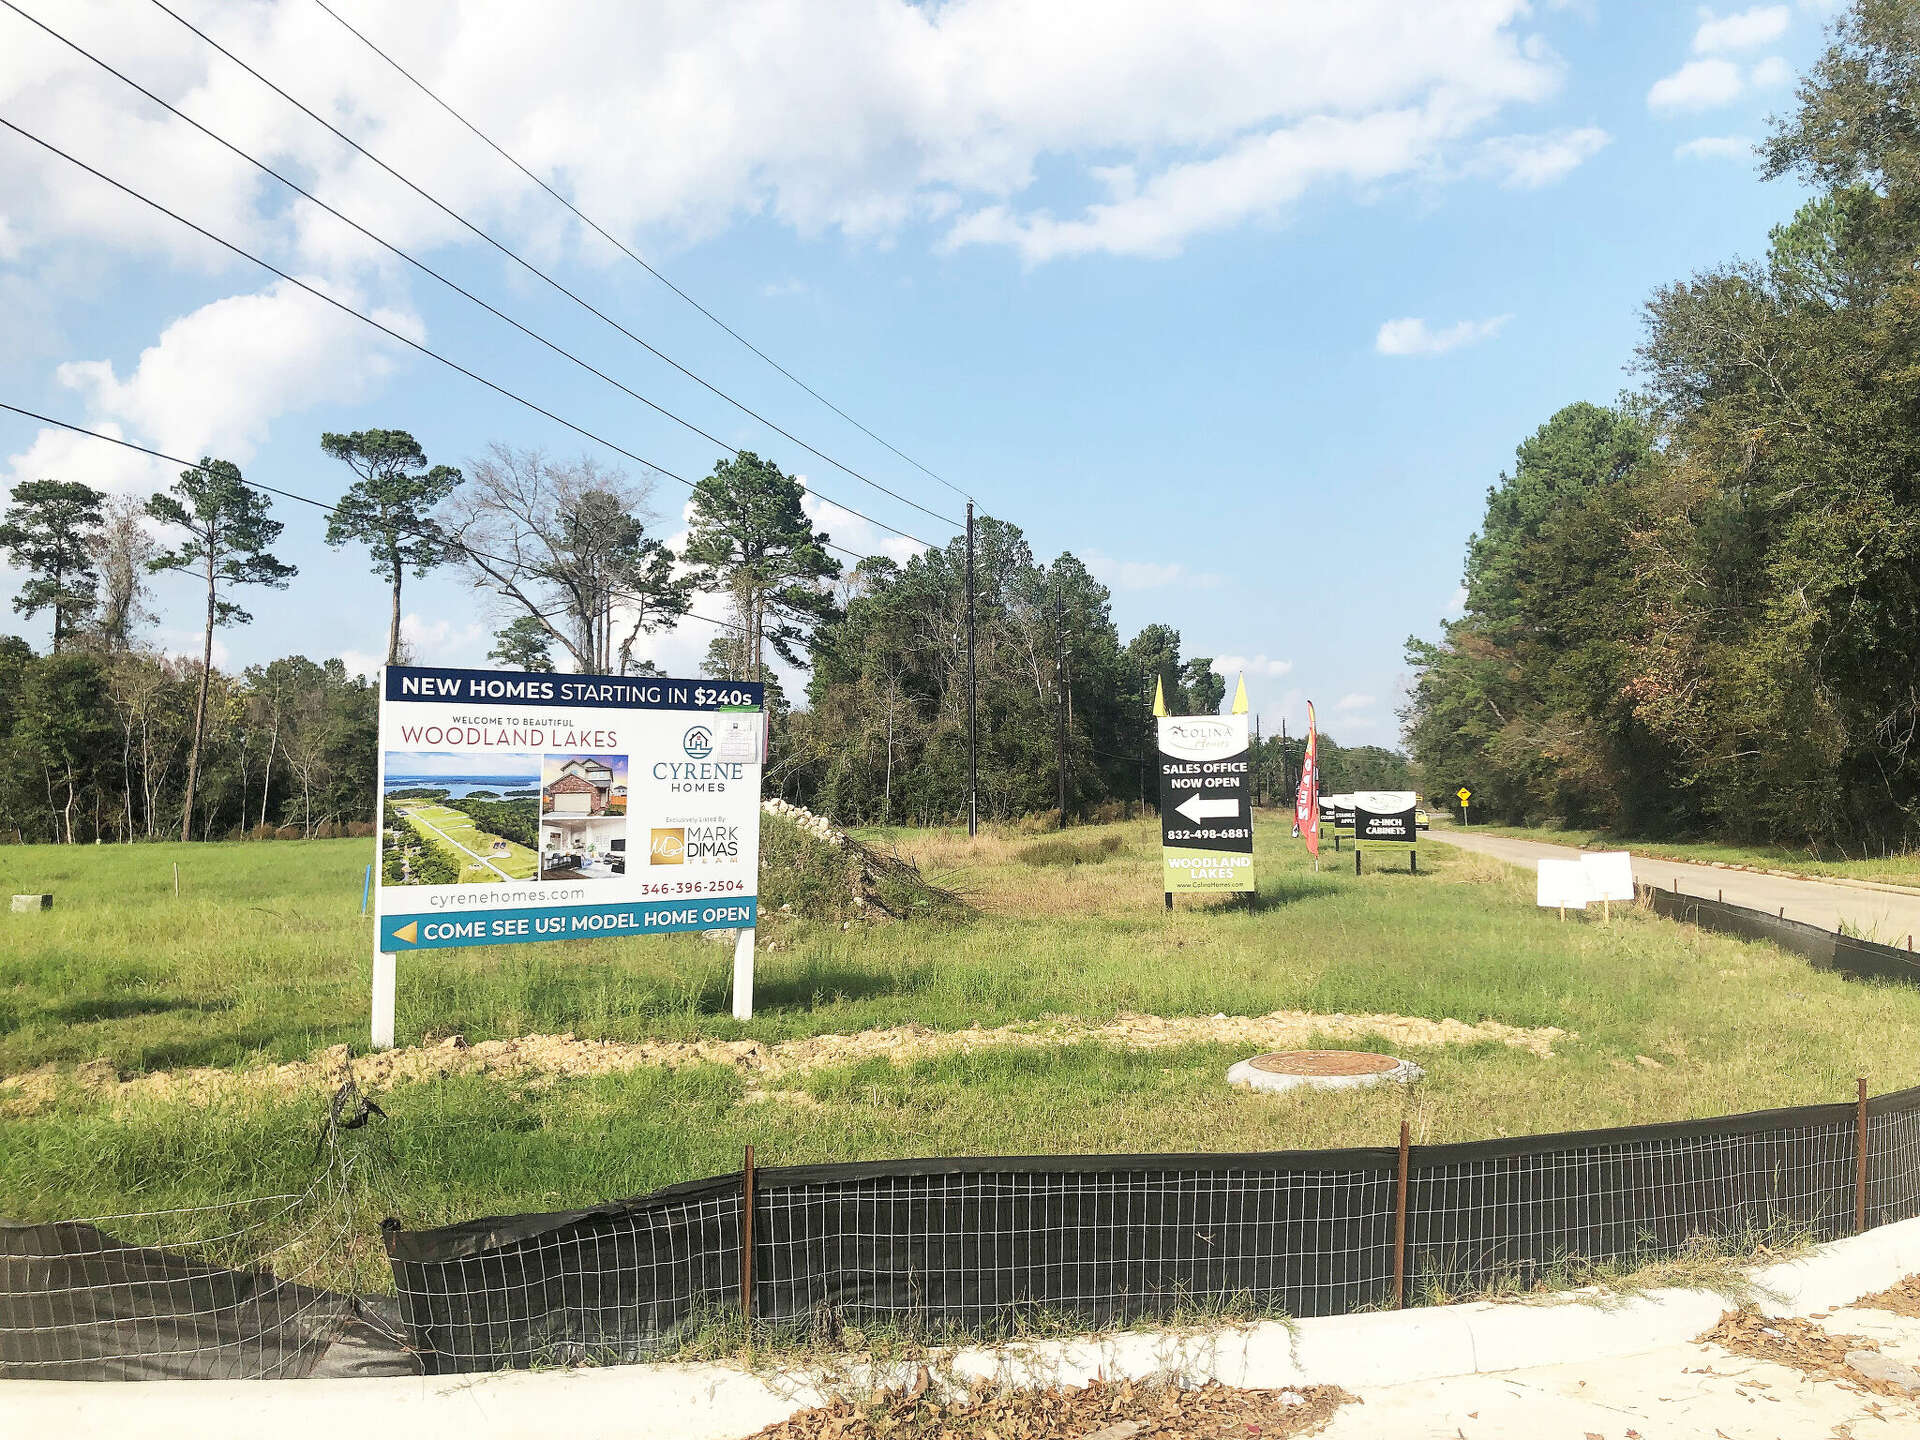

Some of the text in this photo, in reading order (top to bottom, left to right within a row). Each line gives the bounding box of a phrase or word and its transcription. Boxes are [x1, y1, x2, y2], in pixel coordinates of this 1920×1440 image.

[402, 676, 752, 707] NEW HOMES STARTING IN $240s
[452, 715, 574, 728] WELCOME TO BEAUTIFUL
[401, 725, 618, 749] WOODLAND LAKES
[1181, 727, 1233, 738] COLINA
[653, 762, 743, 780] CYRENE
[1162, 762, 1248, 775] SALES OFFICE
[671, 782, 725, 793] HOMES
[1171, 776, 1241, 789] NOW OPEN
[1368, 818, 1403, 827] 42-INCH
[687, 826, 739, 842] MARK
[1167, 828, 1249, 840] 832-498-6881
[1365, 826, 1407, 835] CABINETS
[687, 841, 738, 858] DIMAS
[688, 857, 739, 865] TEAM
[1167, 857, 1251, 869] WOODLAND
[1190, 868, 1234, 879] LAKES
[641, 880, 744, 895] 346-396-2504
[430, 888, 584, 908] cyrenehomes.com
[423, 906, 750, 941] COME SEE US! MODEL HOME OPEN
